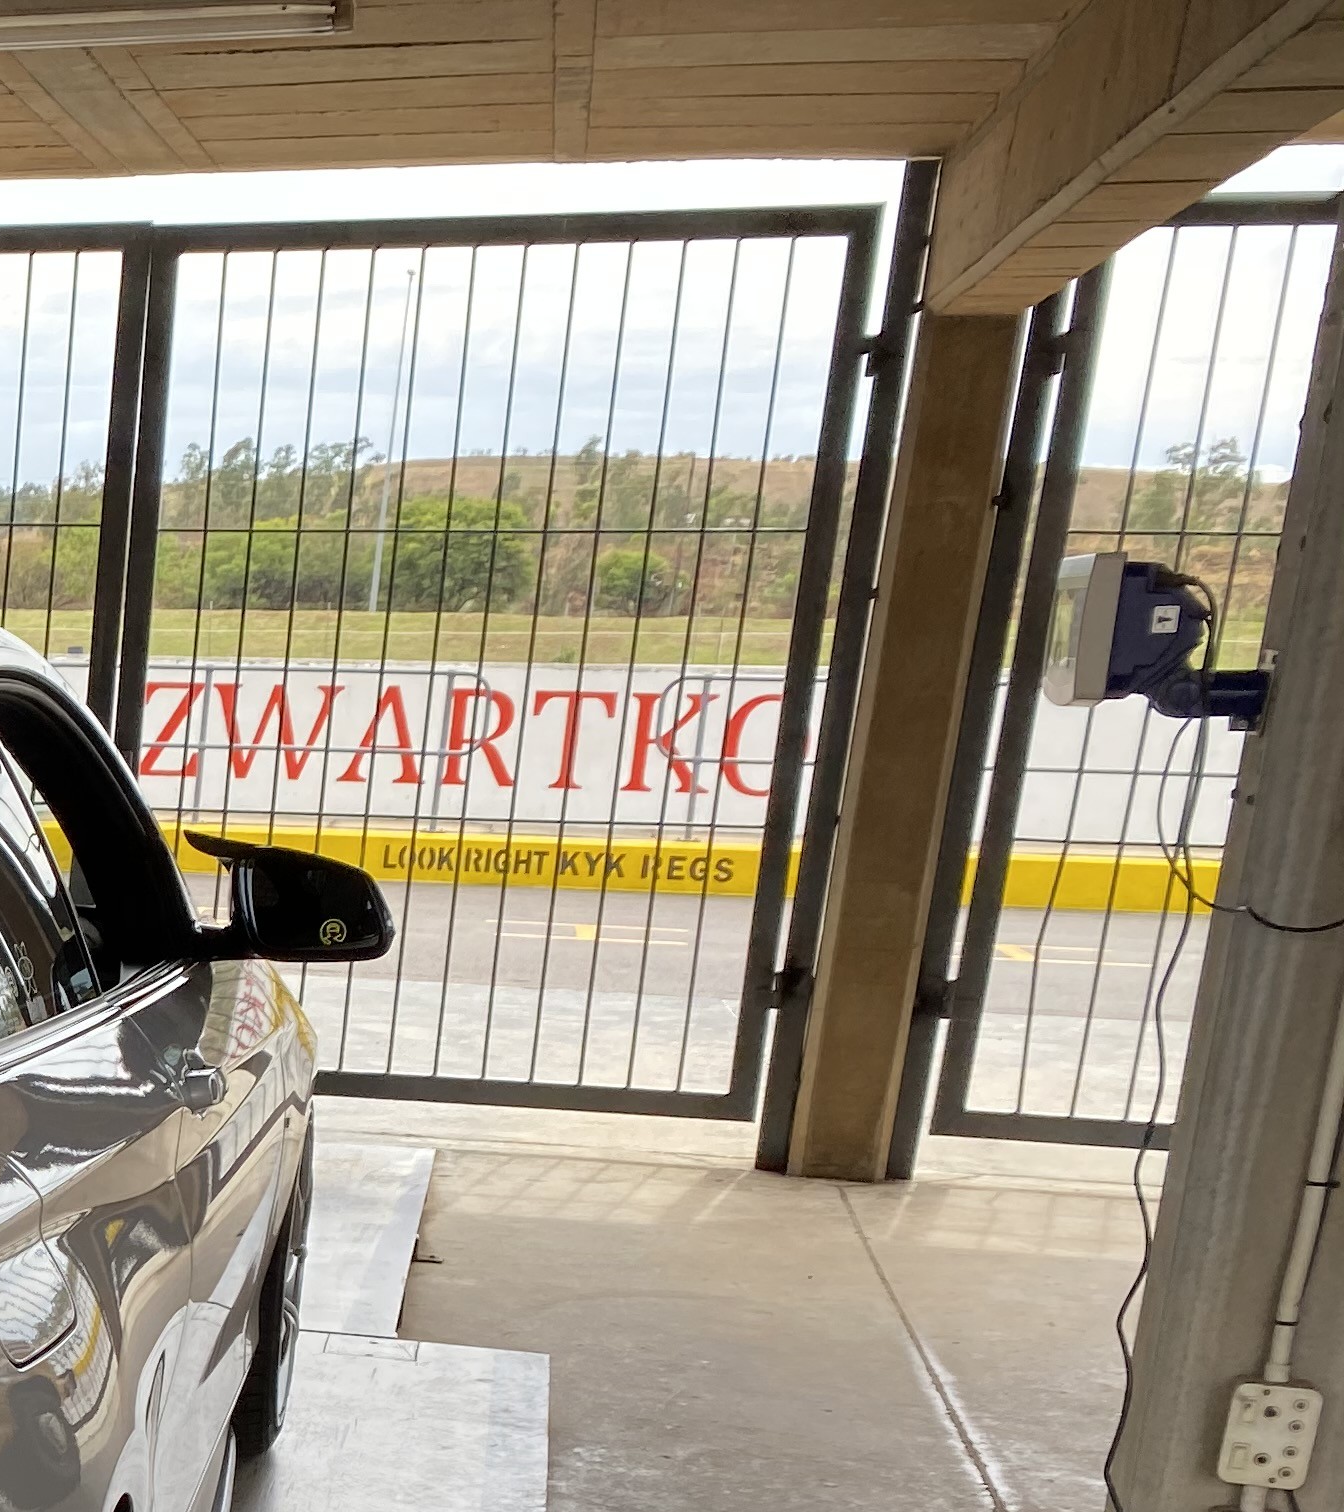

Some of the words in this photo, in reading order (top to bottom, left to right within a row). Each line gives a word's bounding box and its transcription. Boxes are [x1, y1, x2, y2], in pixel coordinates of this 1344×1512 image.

[383, 844, 455, 872] LOOK
[465, 847, 550, 876] RIGHT
[560, 851, 625, 879] KYK
[640, 854, 735, 882] REGS
